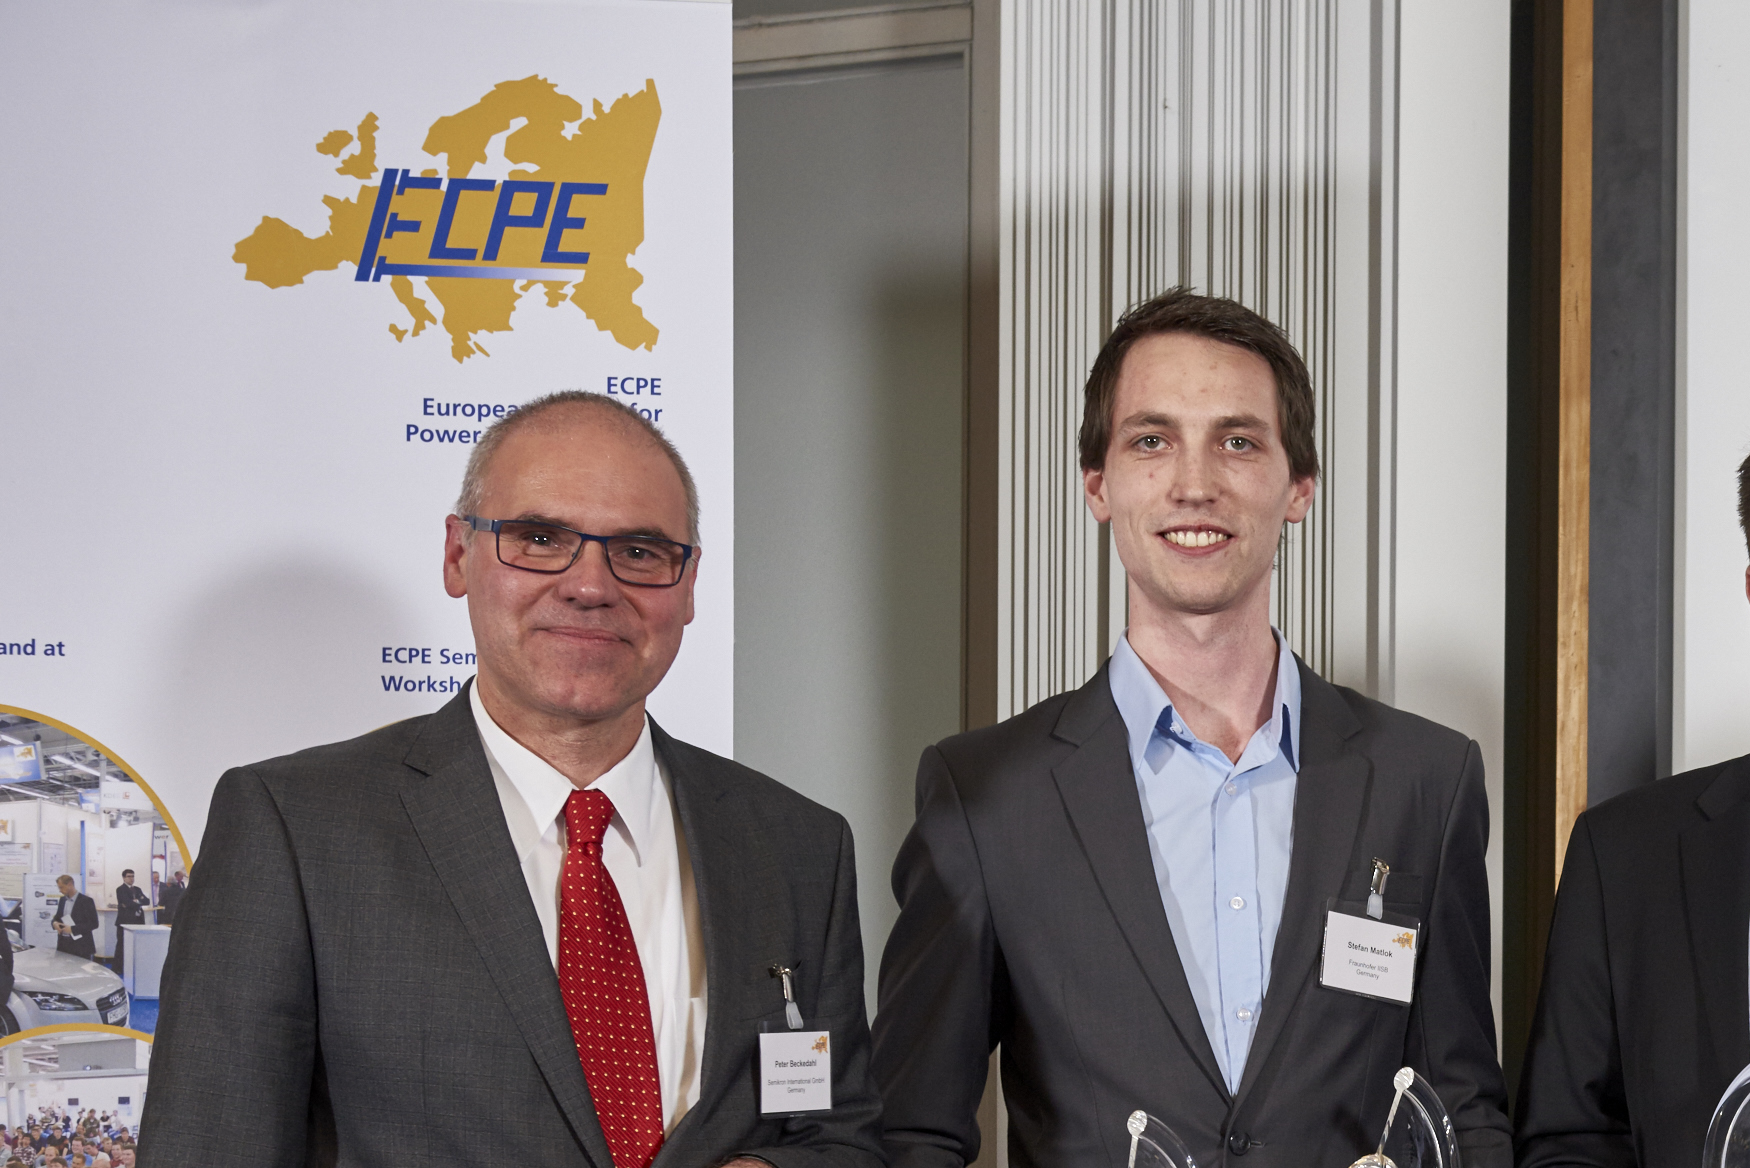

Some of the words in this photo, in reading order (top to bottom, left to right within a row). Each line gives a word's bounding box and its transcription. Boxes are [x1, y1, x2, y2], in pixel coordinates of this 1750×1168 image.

[355, 168, 608, 282] ECPE
[606, 376, 662, 396] ECPE
[406, 424, 481, 443] Power
[43, 641, 65, 657] at
[382, 647, 432, 664] ECPE
[1347, 941, 1369, 953] Stefan
[1370, 946, 1393, 958] Matlok
[1348, 959, 1377, 971] Fraunhofer
[1356, 968, 1380, 980] Germany
[775, 1060, 789, 1068] Peter
[787, 1086, 806, 1094] Germany
